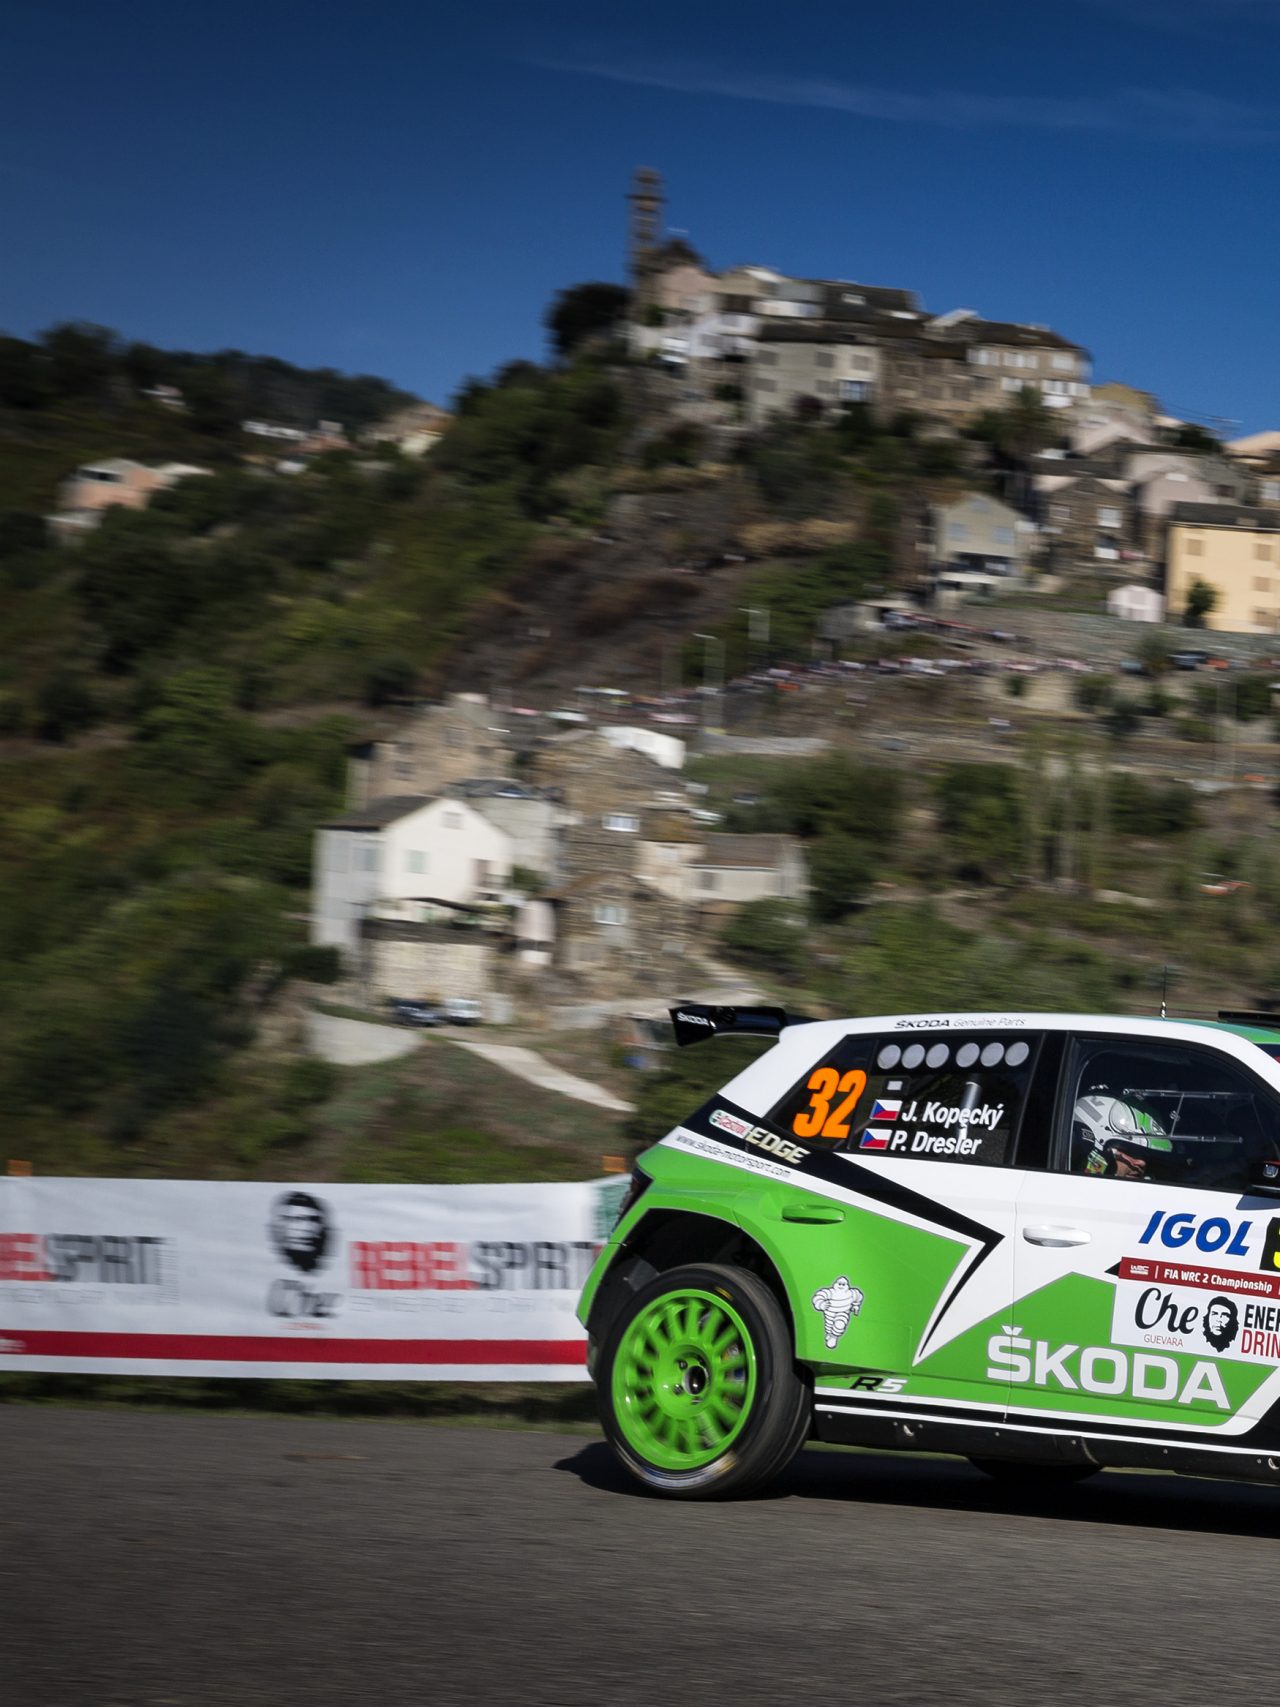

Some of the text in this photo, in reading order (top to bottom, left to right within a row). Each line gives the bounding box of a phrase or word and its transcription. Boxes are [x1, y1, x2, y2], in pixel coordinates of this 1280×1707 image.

[792, 1067, 868, 1139] 32
[901, 1101, 1005, 1131] J. Kopecký
[745, 1126, 812, 1165] EDGE
[890, 1131, 982, 1155] P. Dresler
[1138, 1210, 1253, 1256] IGOL
[1163, 1268, 1179, 1280] FIA
[1181, 1270, 1202, 1283] WRC
[1202, 1273, 1210, 1284] 2
[1211, 1274, 1273, 1295] Championship
[1134, 1287, 1200, 1335] Che
[1143, 1333, 1184, 1348] GUEVARA
[849, 1376, 908, 1393] R5
[986, 1325, 1232, 1410] ŠKODA
